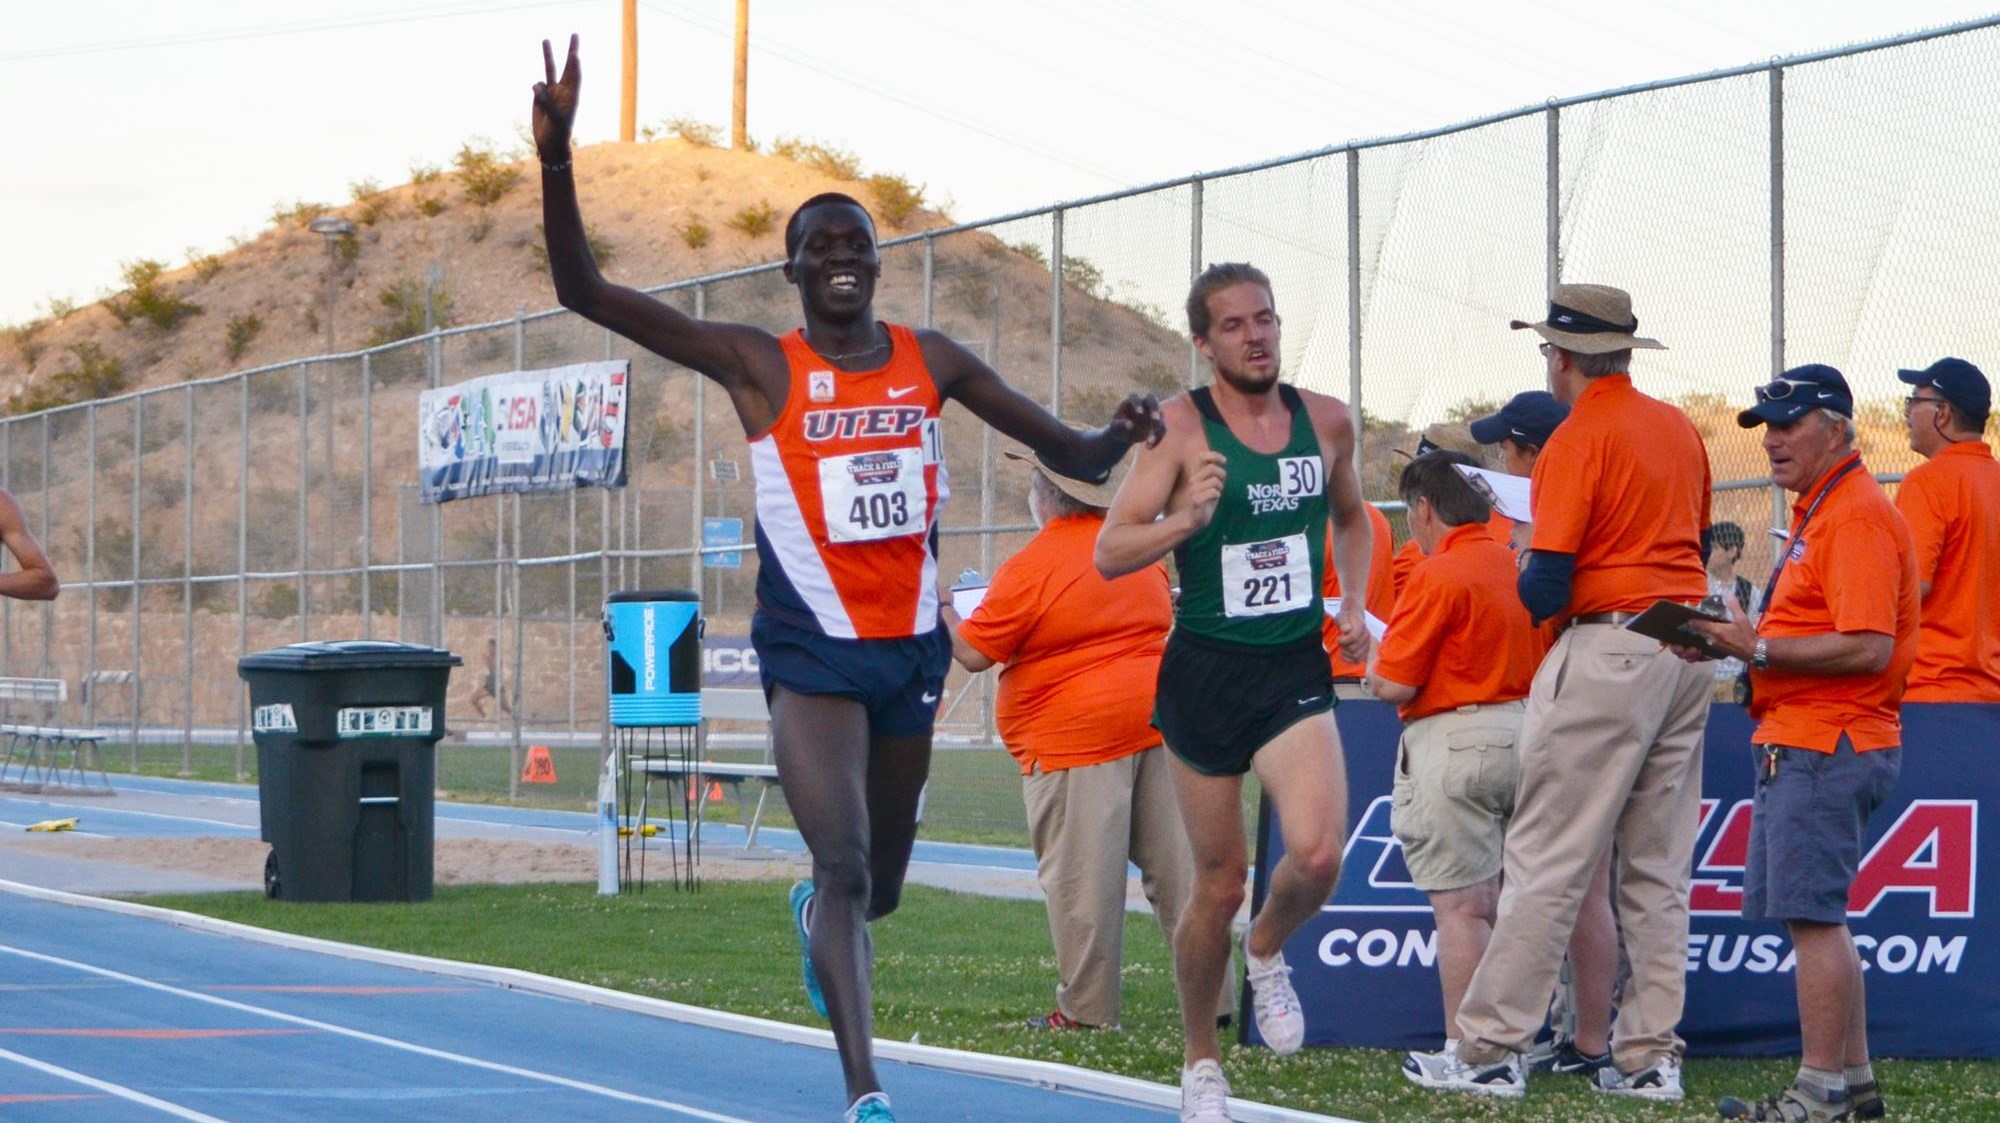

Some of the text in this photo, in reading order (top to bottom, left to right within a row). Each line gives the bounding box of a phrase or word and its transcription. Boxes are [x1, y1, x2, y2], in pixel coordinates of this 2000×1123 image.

[804, 406, 926, 441] UTEP
[927, 420, 943, 461] 1
[1247, 484, 1282, 500] NOR
[1285, 459, 1316, 495] 30
[849, 491, 909, 530] 403
[1252, 497, 1299, 515] TEXAS
[1244, 573, 1291, 608] 221
[644, 608, 655, 691] POWERADE
